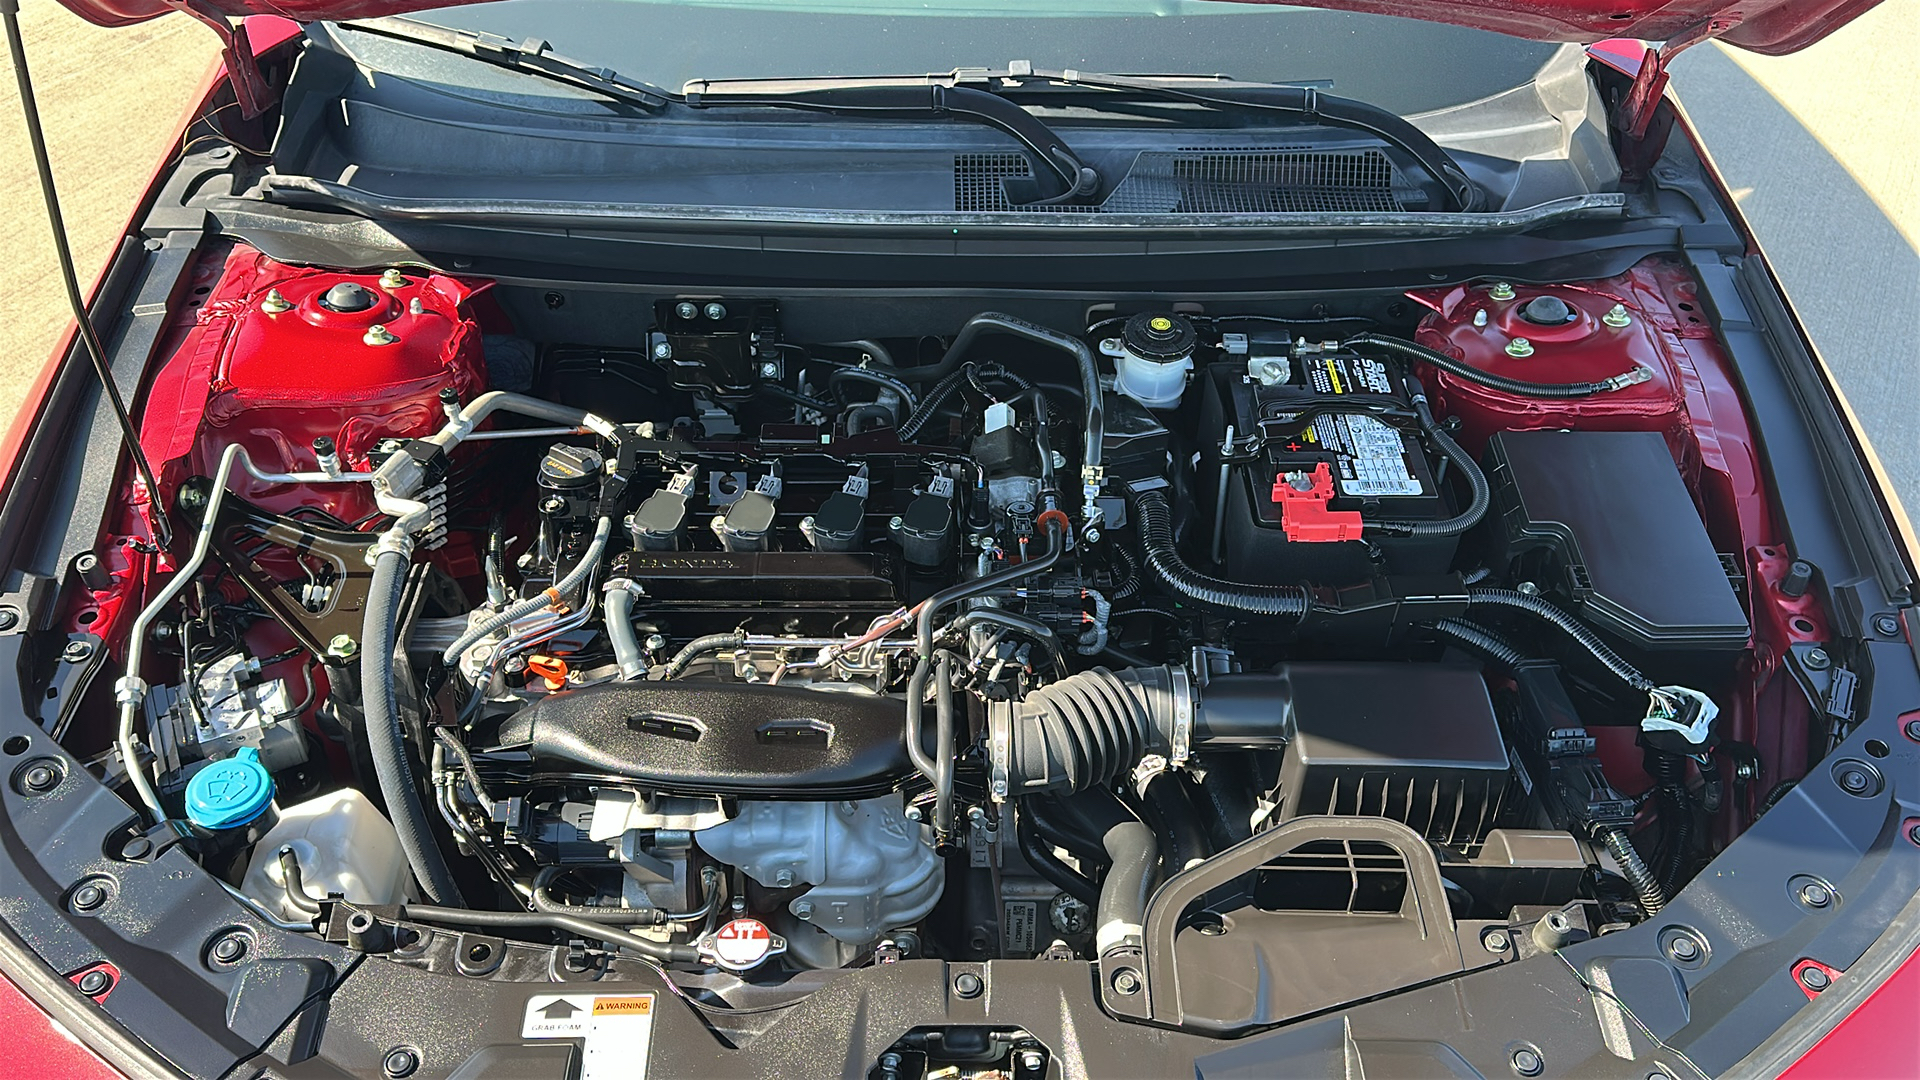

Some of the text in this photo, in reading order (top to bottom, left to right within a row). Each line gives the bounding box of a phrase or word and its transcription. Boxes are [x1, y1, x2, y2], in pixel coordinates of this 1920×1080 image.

[1361, 358, 1380, 393] START
[639, 558, 739, 569] HONDA
[605, 1002, 649, 1011] WARNING
[531, 1023, 582, 1031] GRAB FOAM
